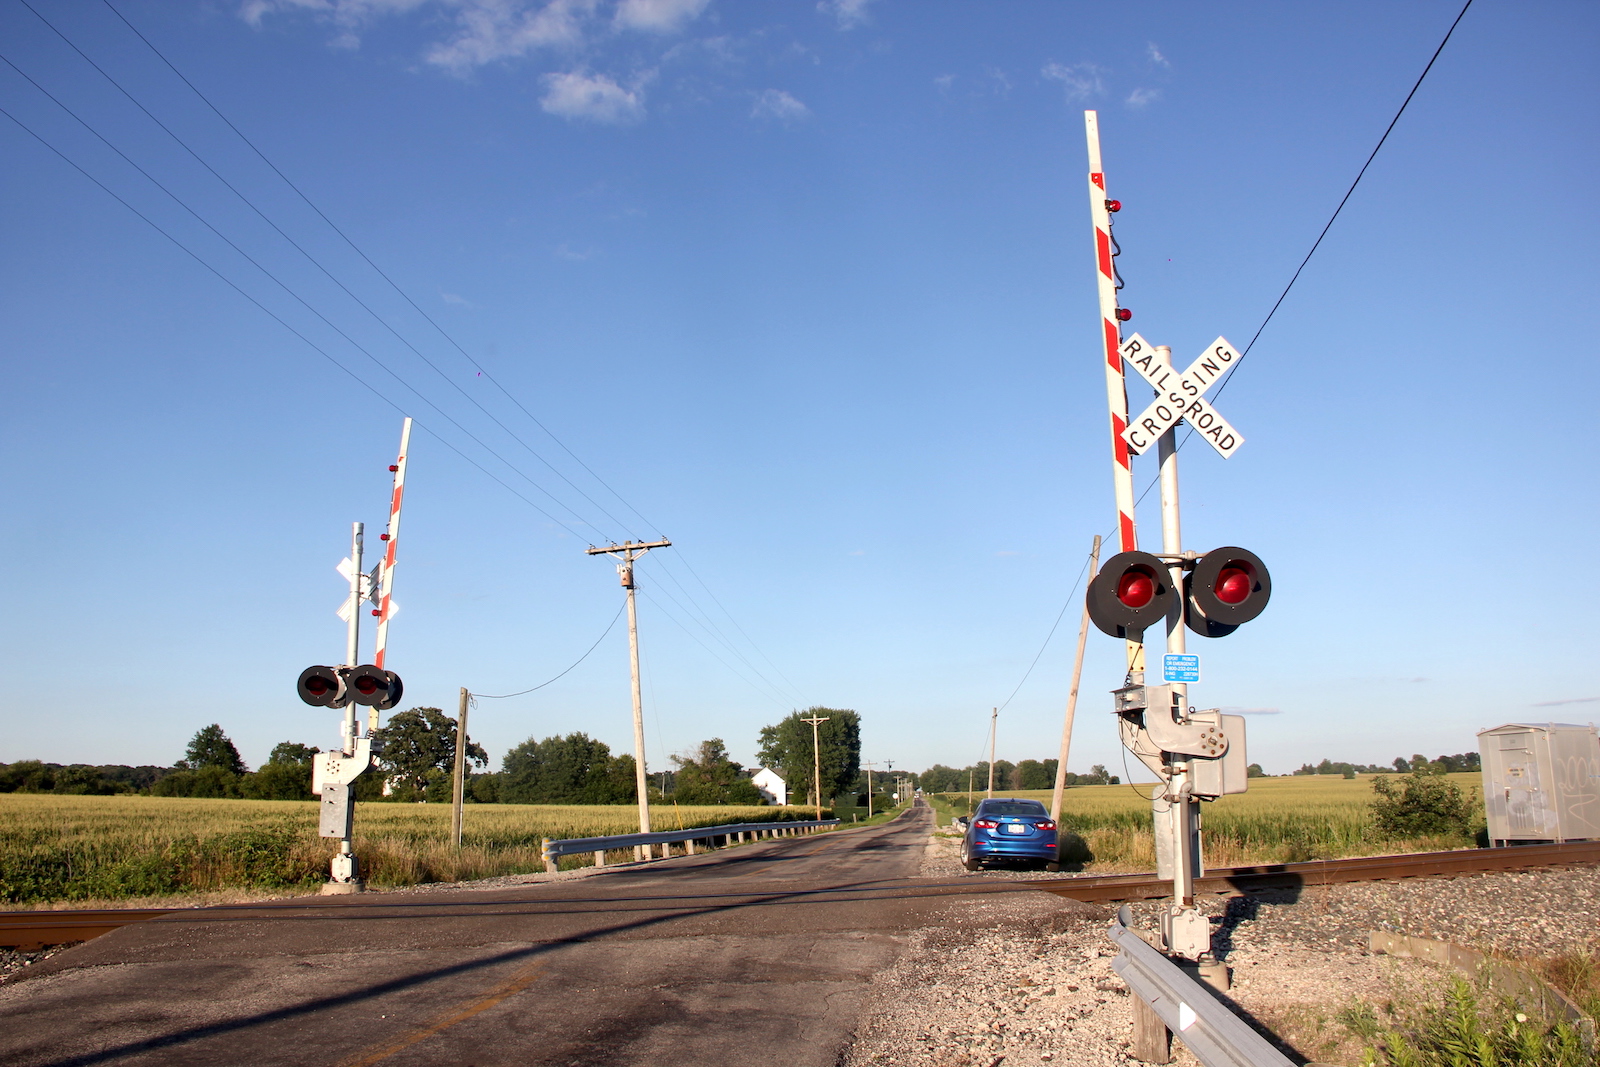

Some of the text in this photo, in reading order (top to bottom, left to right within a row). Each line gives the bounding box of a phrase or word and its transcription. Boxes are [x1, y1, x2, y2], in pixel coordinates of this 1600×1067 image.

[1124, 340, 1235, 451] RAIL ROAD
[1130, 346, 1232, 448] CROSSING
